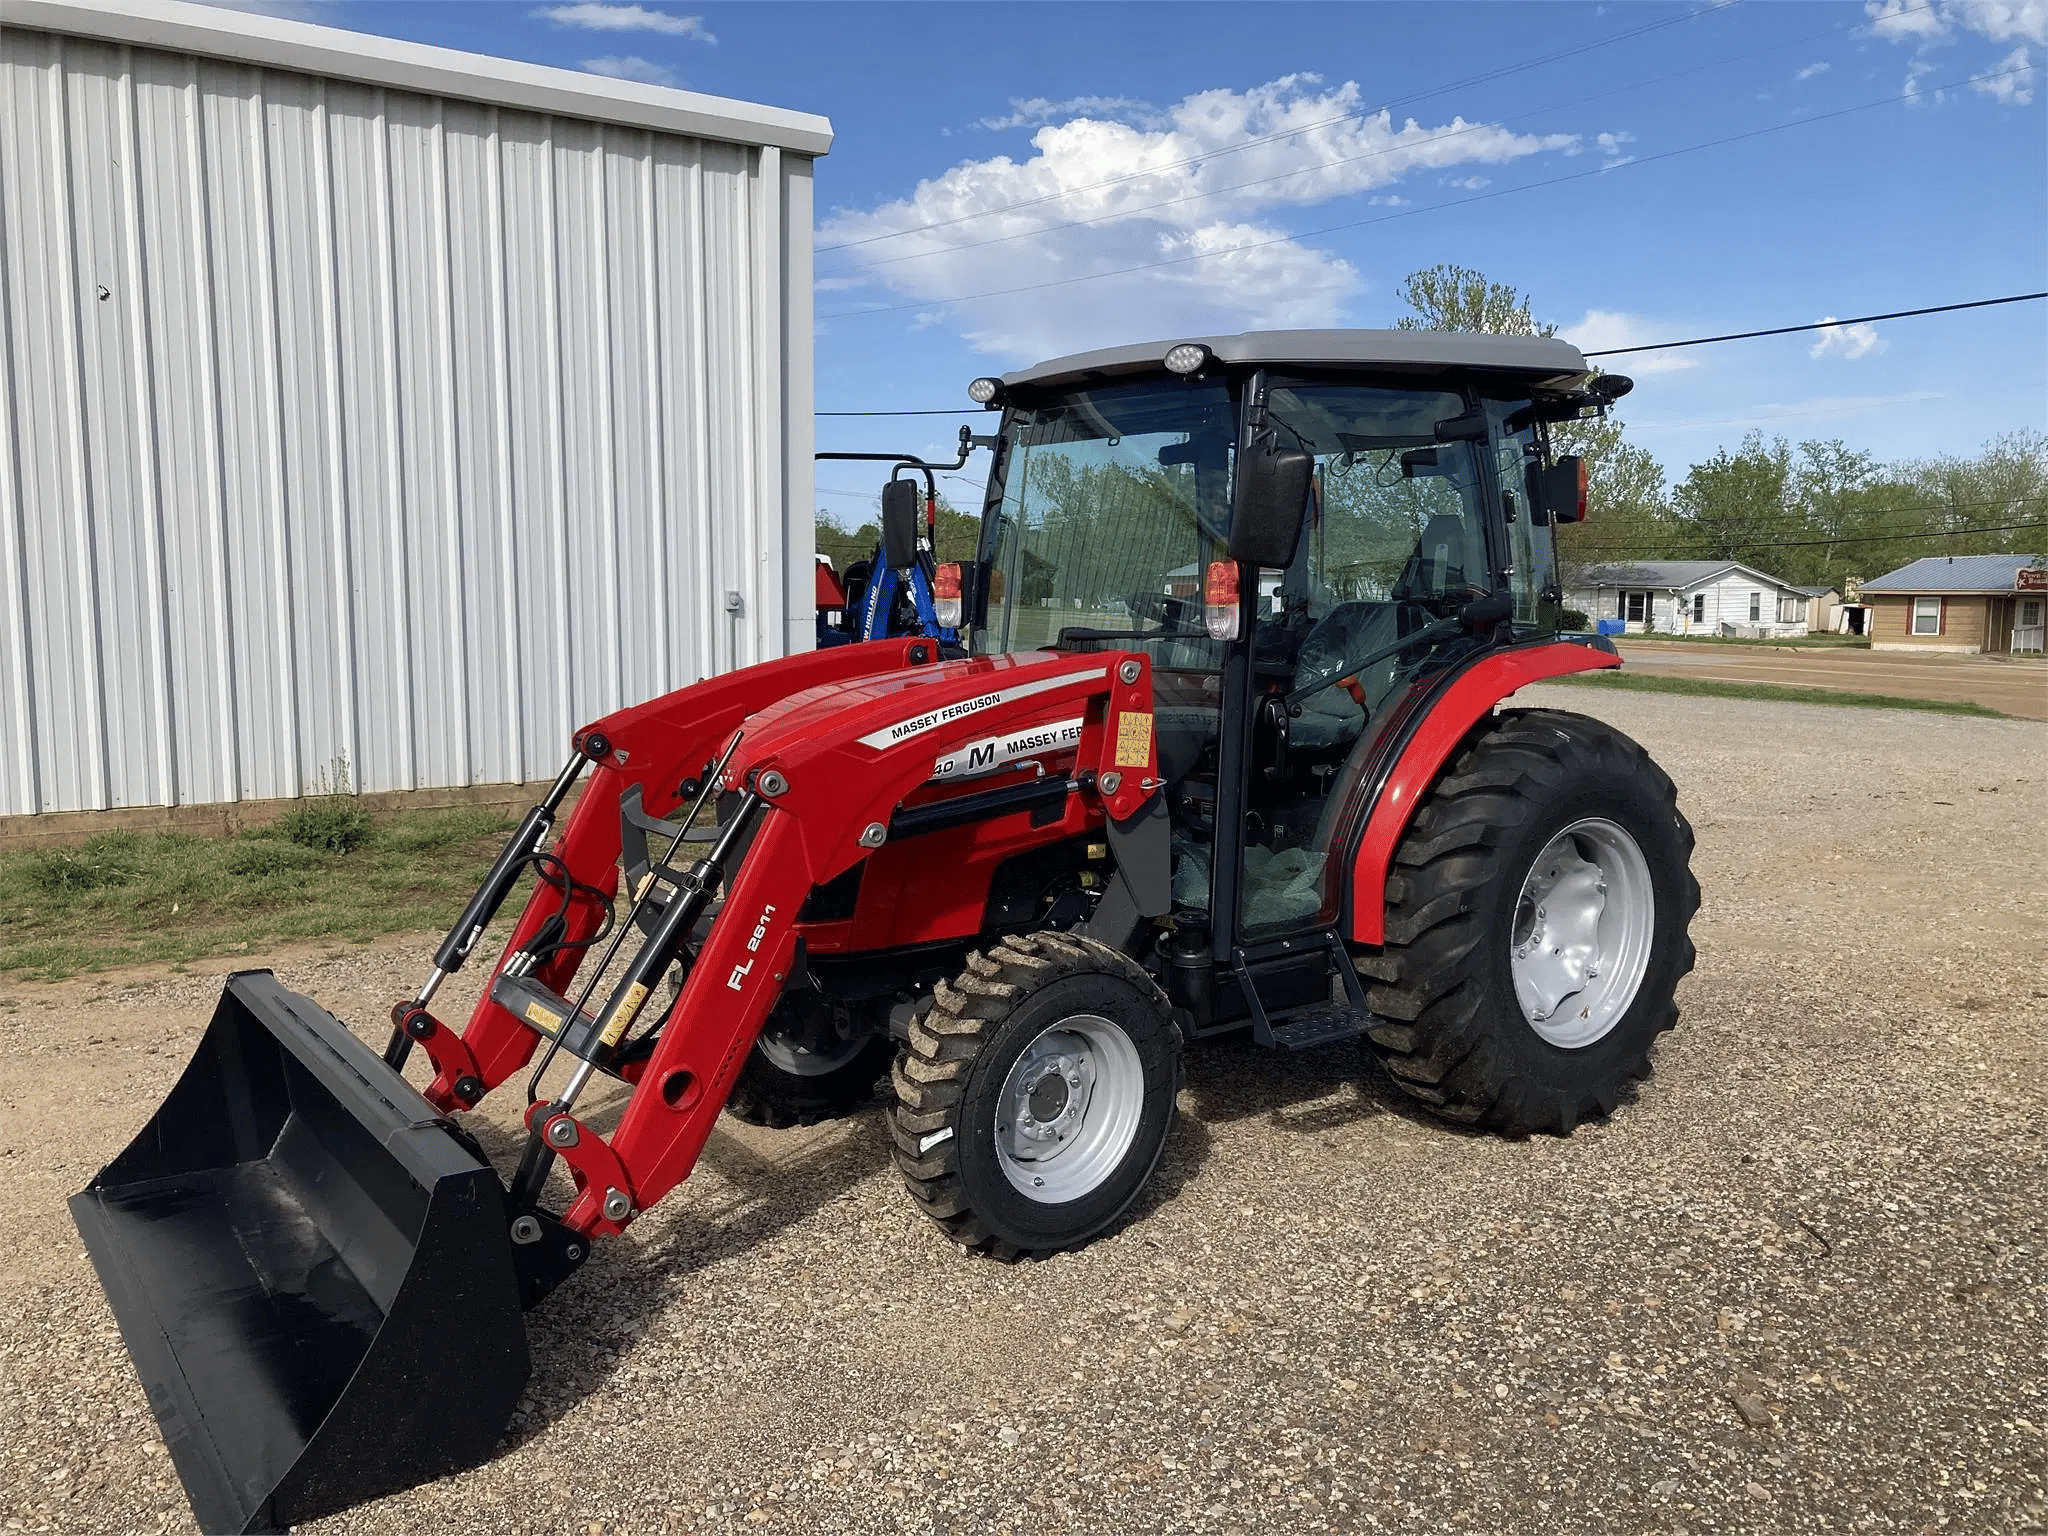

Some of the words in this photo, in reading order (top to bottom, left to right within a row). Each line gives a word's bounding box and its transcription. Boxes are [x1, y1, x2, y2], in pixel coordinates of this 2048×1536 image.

[865, 585, 877, 628] HOLLAND
[892, 713, 938, 739] MASSEY
[942, 693, 1001, 720] FERGUSON
[968, 742, 995, 769] M
[1007, 731, 1058, 754] MASSEY
[727, 958, 755, 991] FL
[747, 904, 776, 952] 2611
